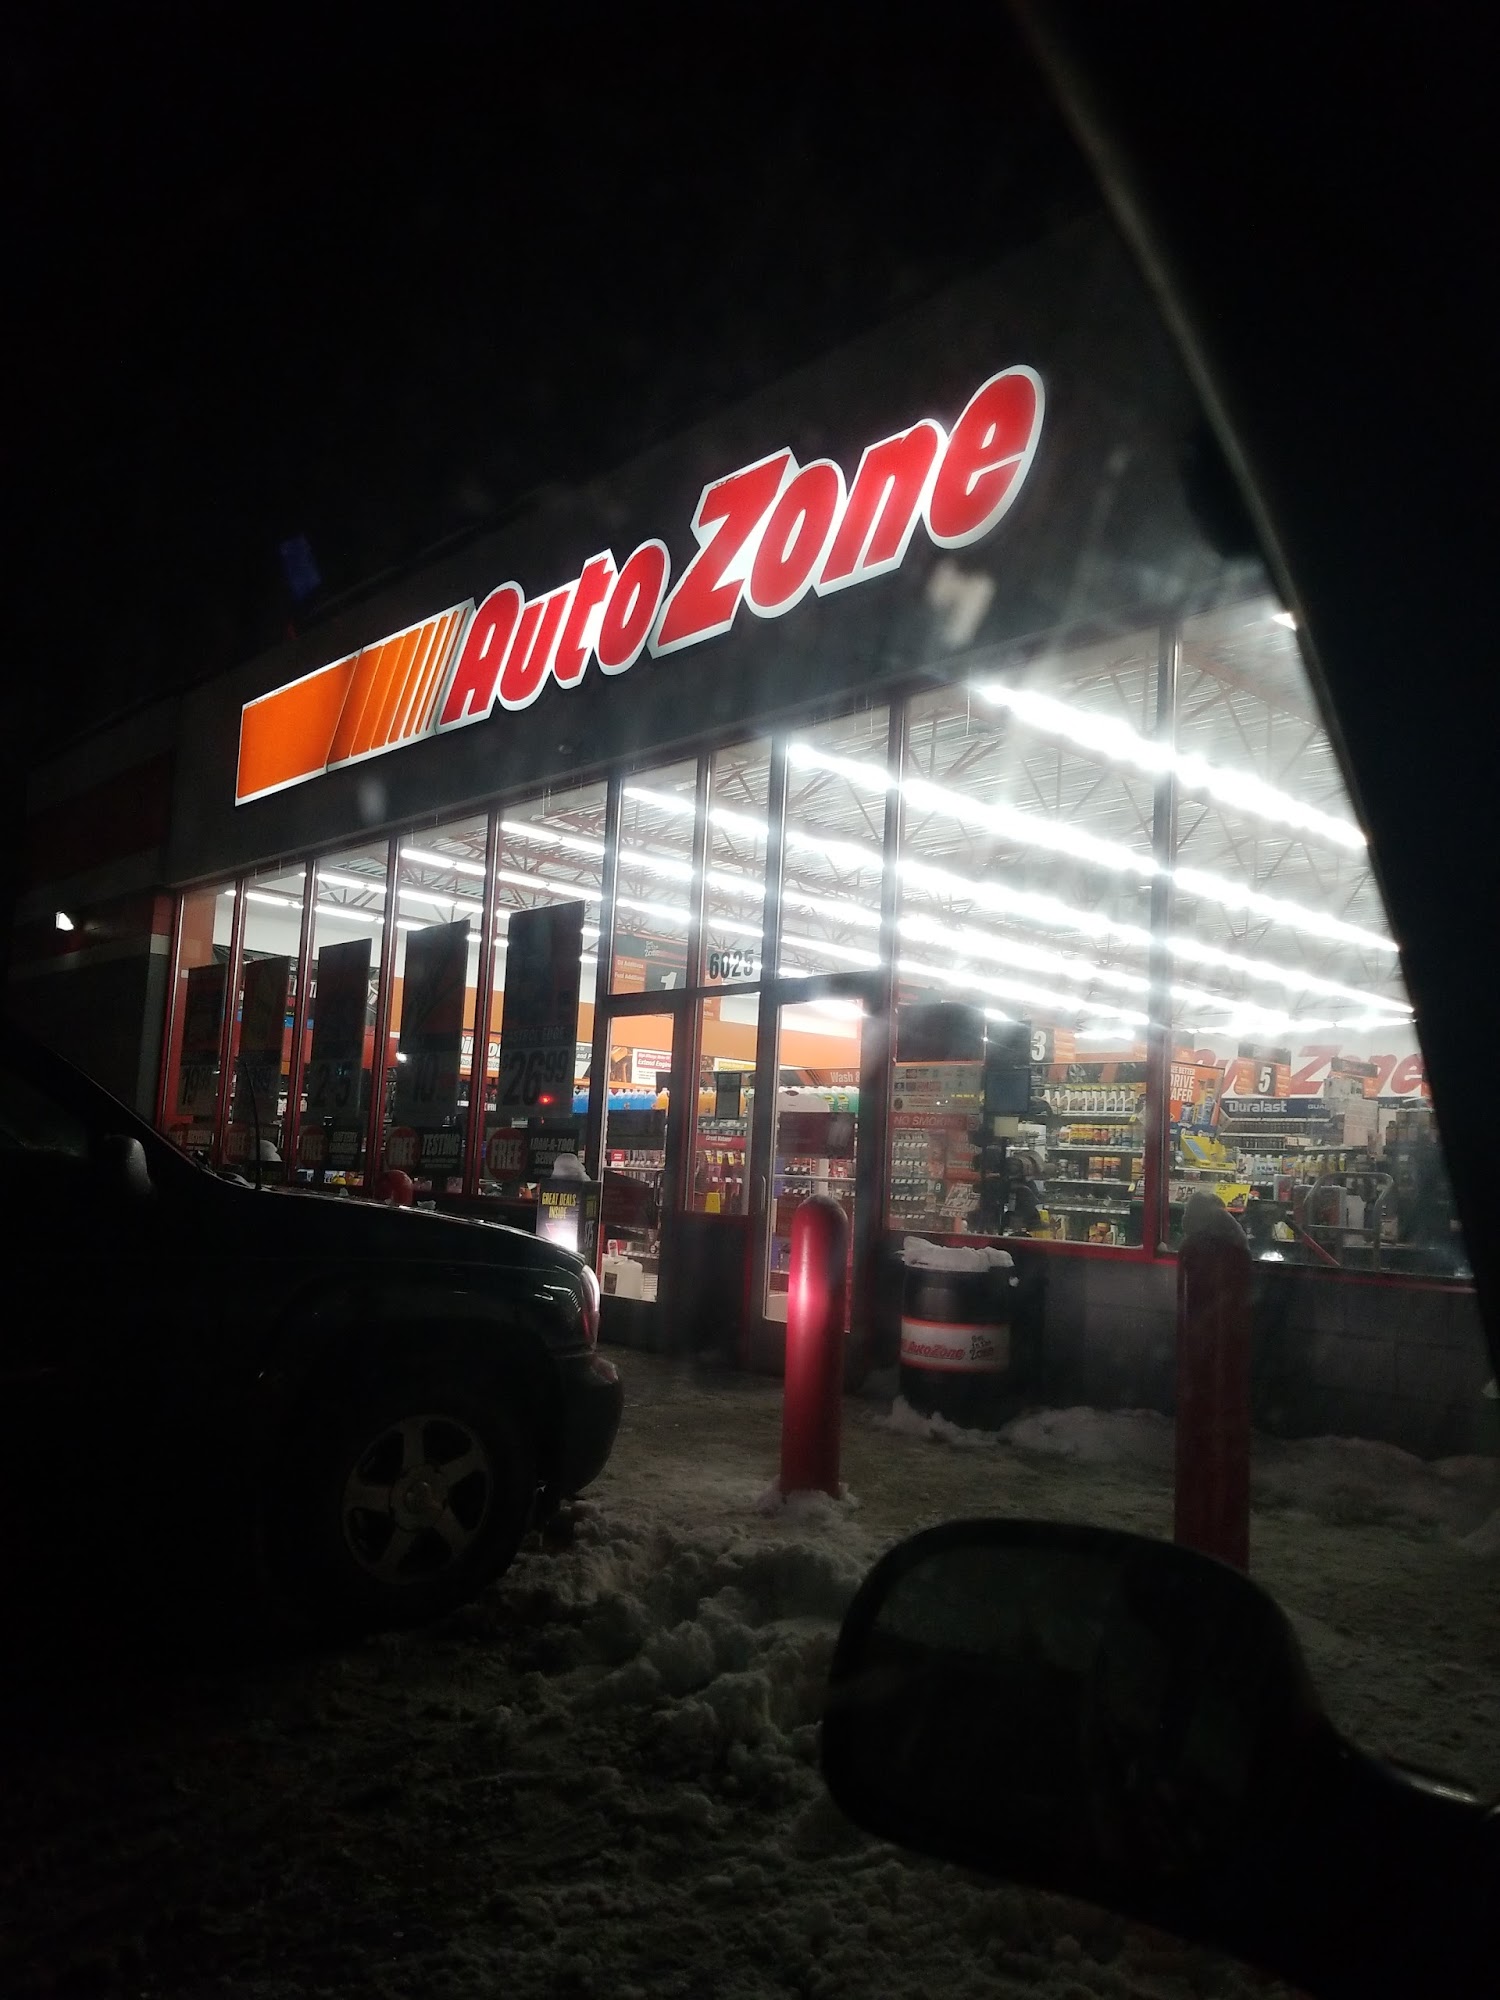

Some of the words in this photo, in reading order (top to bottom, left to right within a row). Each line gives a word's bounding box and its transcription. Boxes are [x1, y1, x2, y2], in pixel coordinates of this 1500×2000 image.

[438, 366, 1044, 730] AutoZone
[709, 949, 755, 980] 6025
[660, 971, 678, 990] 1
[1031, 1030, 1047, 1061] 3
[830, 1071, 854, 1083] Wash
[1258, 1066, 1273, 1093] 5
[1170, 1087, 1193, 1103] AFER
[1224, 1100, 1288, 1113] Duralast
[422, 1133, 460, 1155] TESTING
[490, 1138, 523, 1171] FREE
[541, 1192, 559, 1206] GREAT
[559, 1193, 577, 1207] DEALS
[907, 1341, 965, 1360] AutoZone
